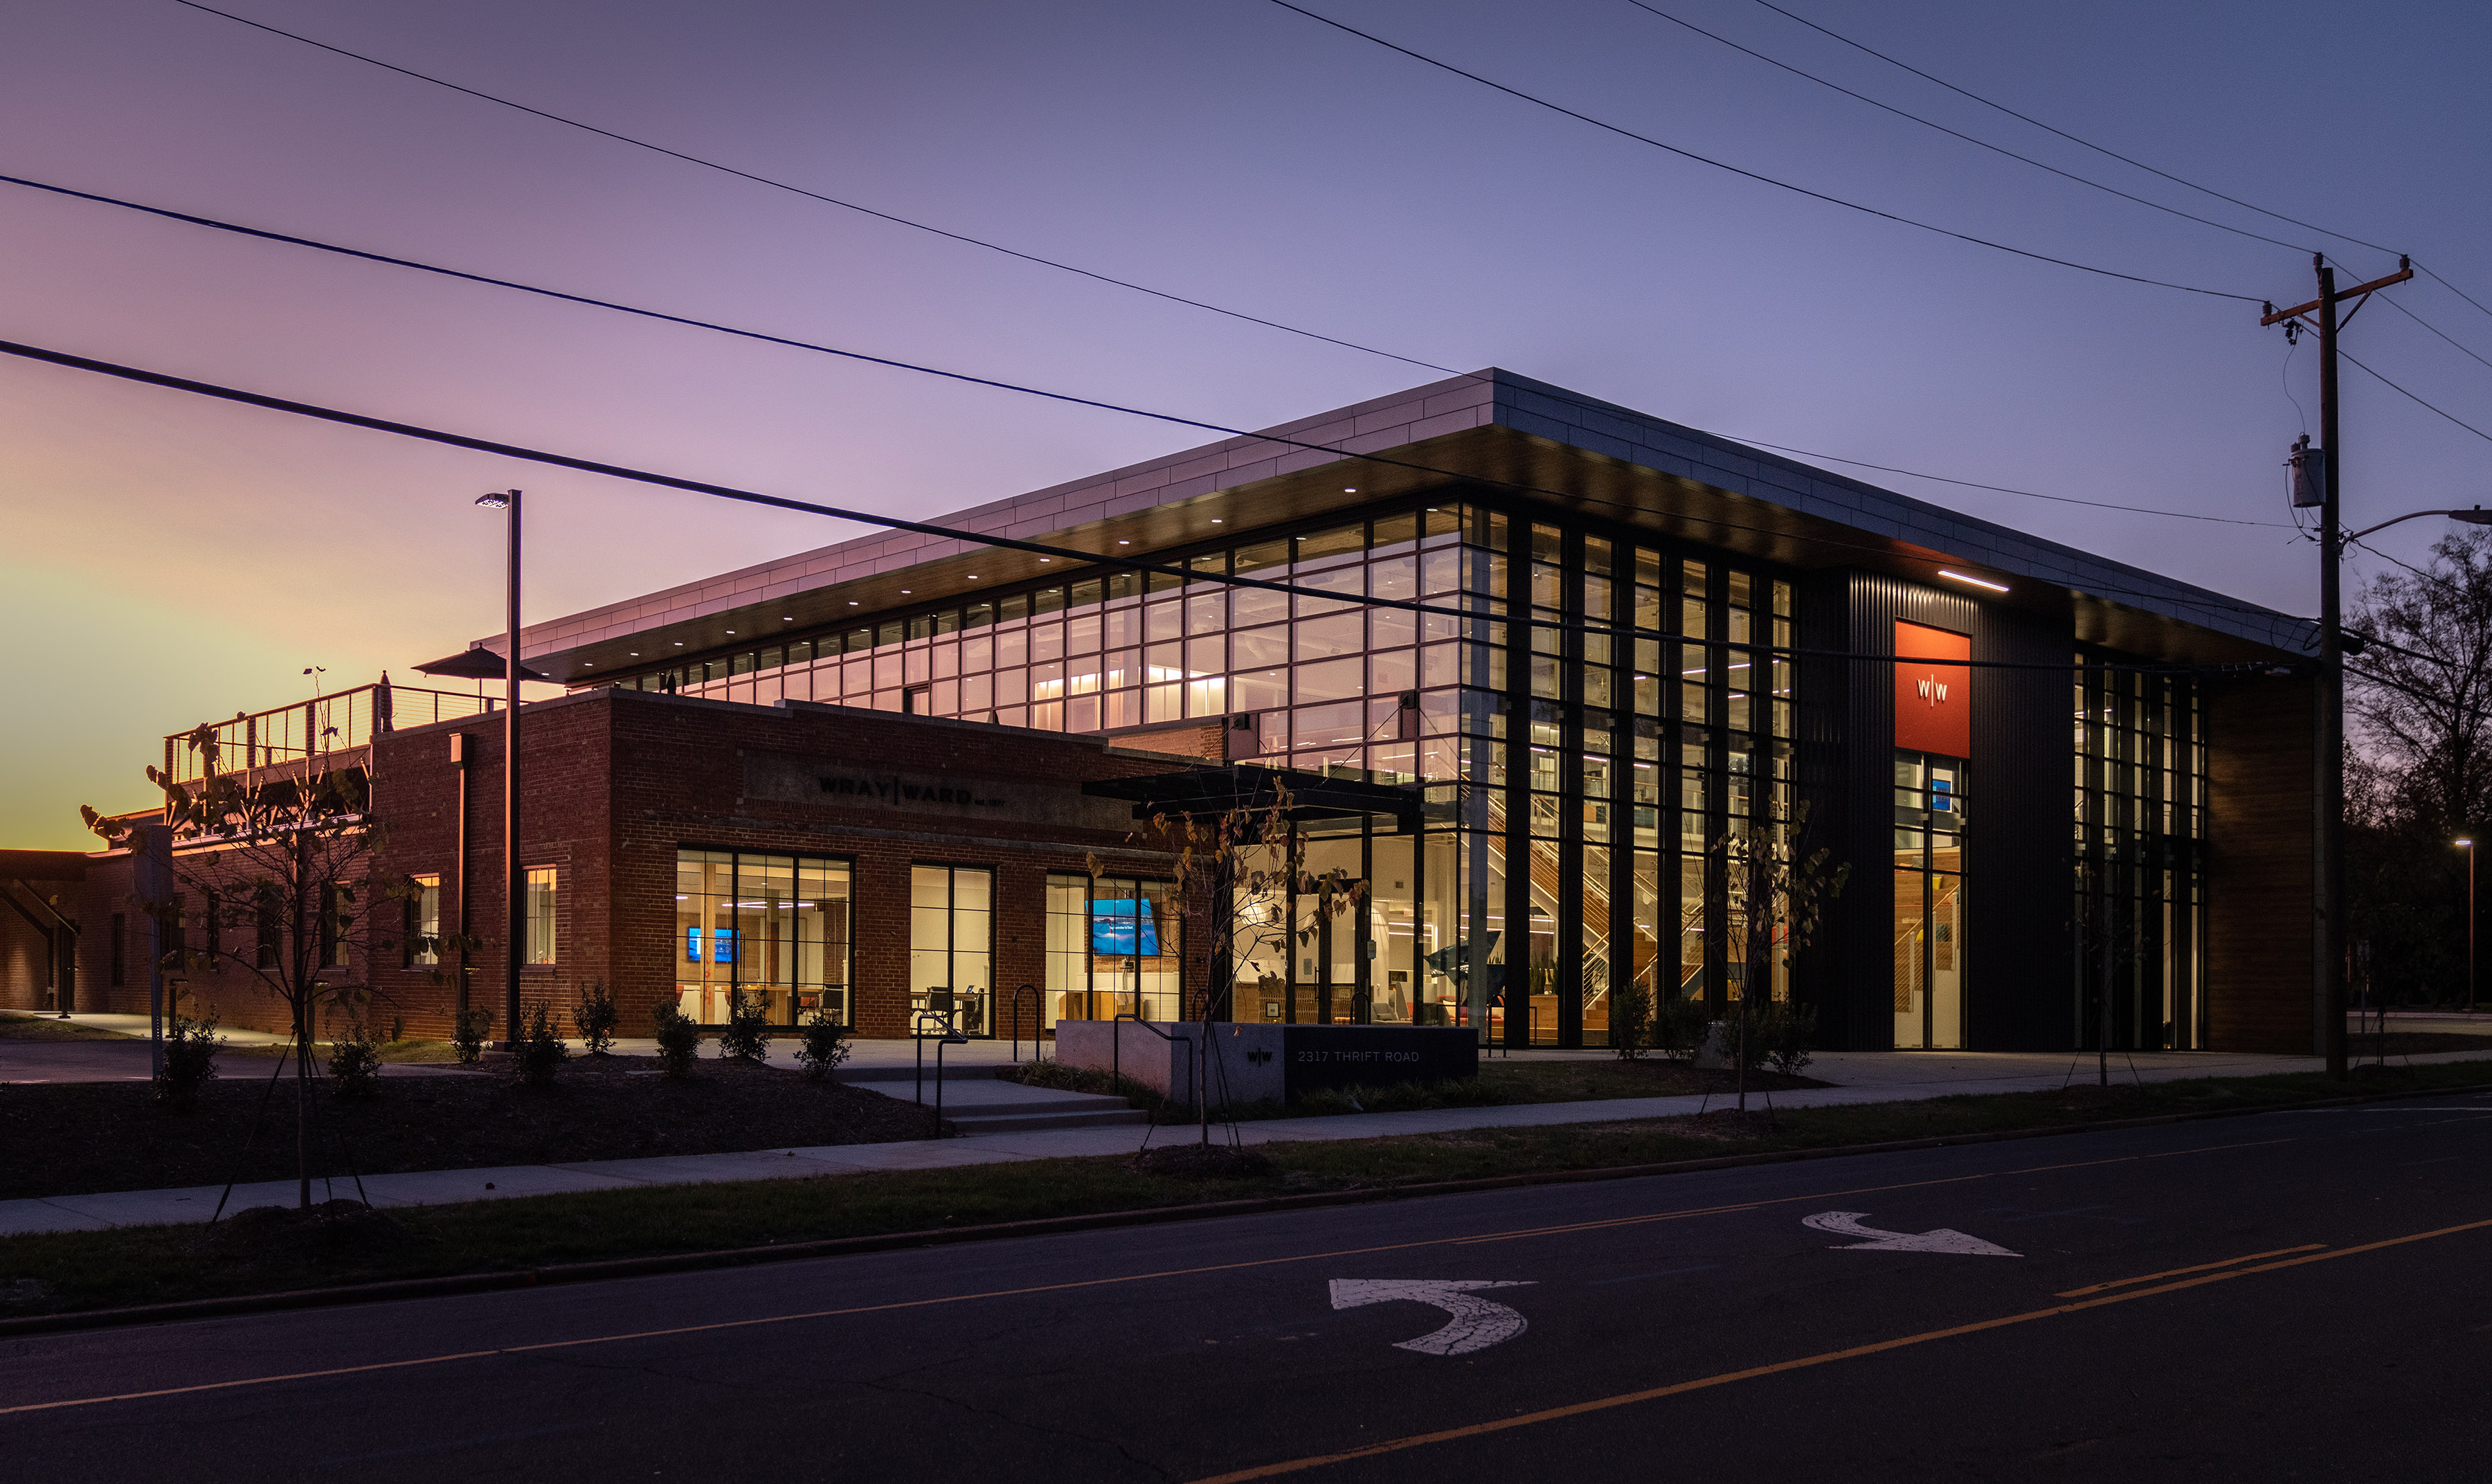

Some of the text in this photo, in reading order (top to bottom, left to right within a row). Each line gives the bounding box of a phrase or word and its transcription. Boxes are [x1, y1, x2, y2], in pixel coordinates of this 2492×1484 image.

[1298, 1051, 1419, 1062] 2317 THRIFT ROAD
